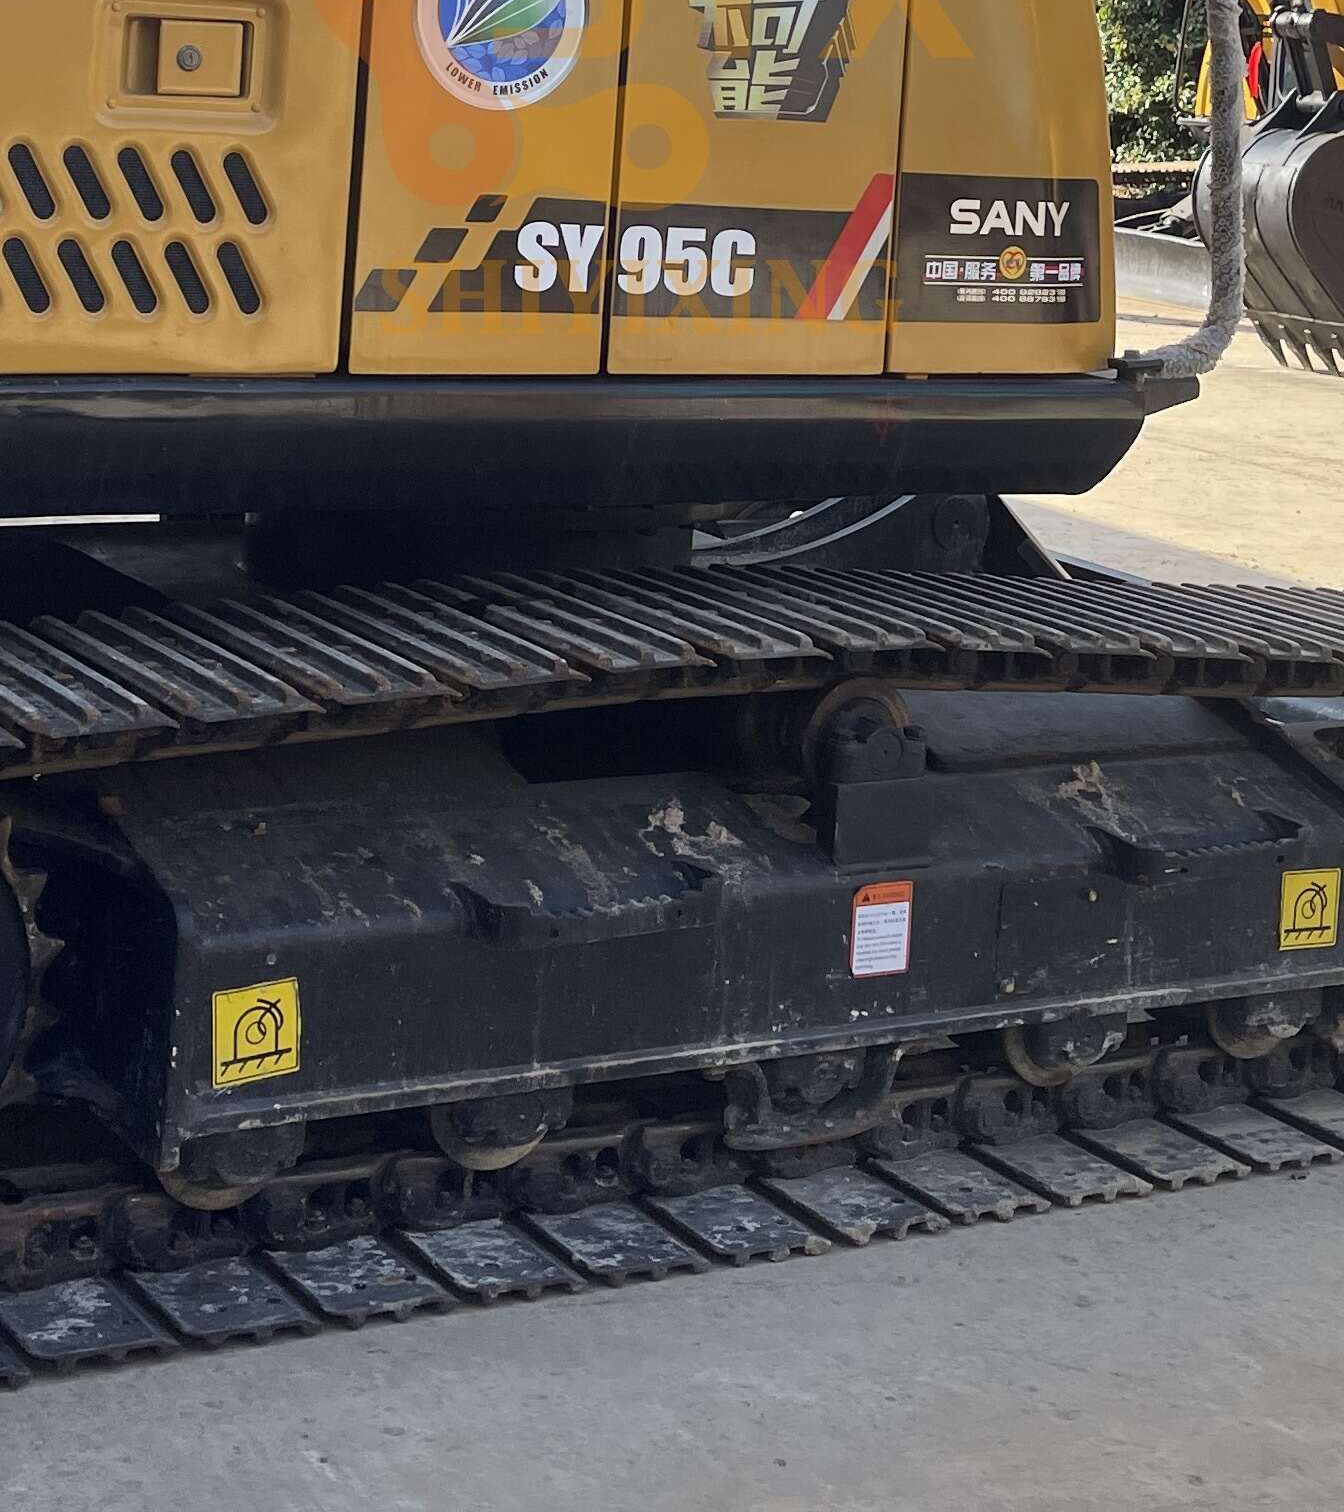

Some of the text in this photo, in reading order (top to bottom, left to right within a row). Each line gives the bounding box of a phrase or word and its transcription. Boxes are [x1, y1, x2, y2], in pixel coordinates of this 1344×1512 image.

[445, 61, 549, 97] LOWER EMISSION
[949, 199, 1070, 237] SANY
